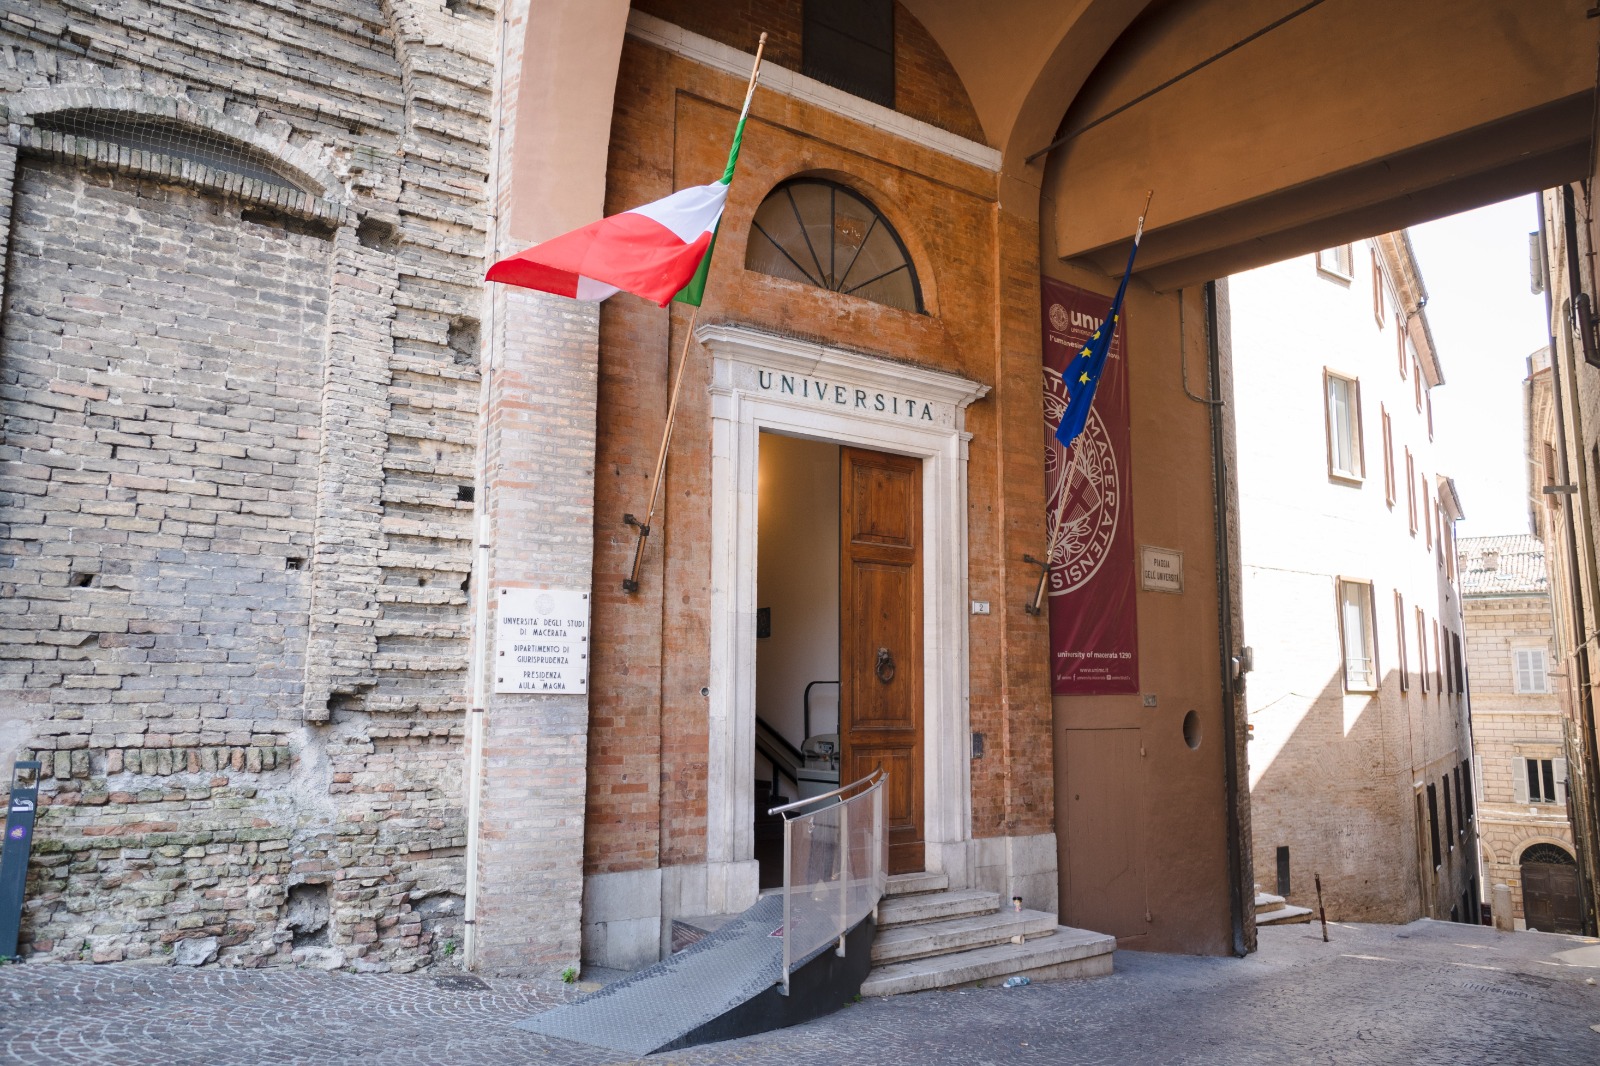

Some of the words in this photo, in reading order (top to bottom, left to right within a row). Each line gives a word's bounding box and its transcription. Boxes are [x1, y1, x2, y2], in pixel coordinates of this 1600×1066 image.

[979, 603, 984, 611] 2
[543, 618, 562, 627] DEGLI
[567, 619, 585, 628] STUDI
[519, 628, 527, 636] DI
[532, 629, 567, 637] MACERATA
[513, 644, 560, 653] DIPARTIMENTO
[516, 655, 569, 664] GIURISPRUDENZA
[1057, 650, 1085, 660] university
[1086, 650, 1094, 658] of
[1094, 651, 1118, 659] macerata
[523, 670, 561, 679] PRESIDENZA
[518, 682, 535, 690] AULA
[542, 682, 566, 690] MAGNA
